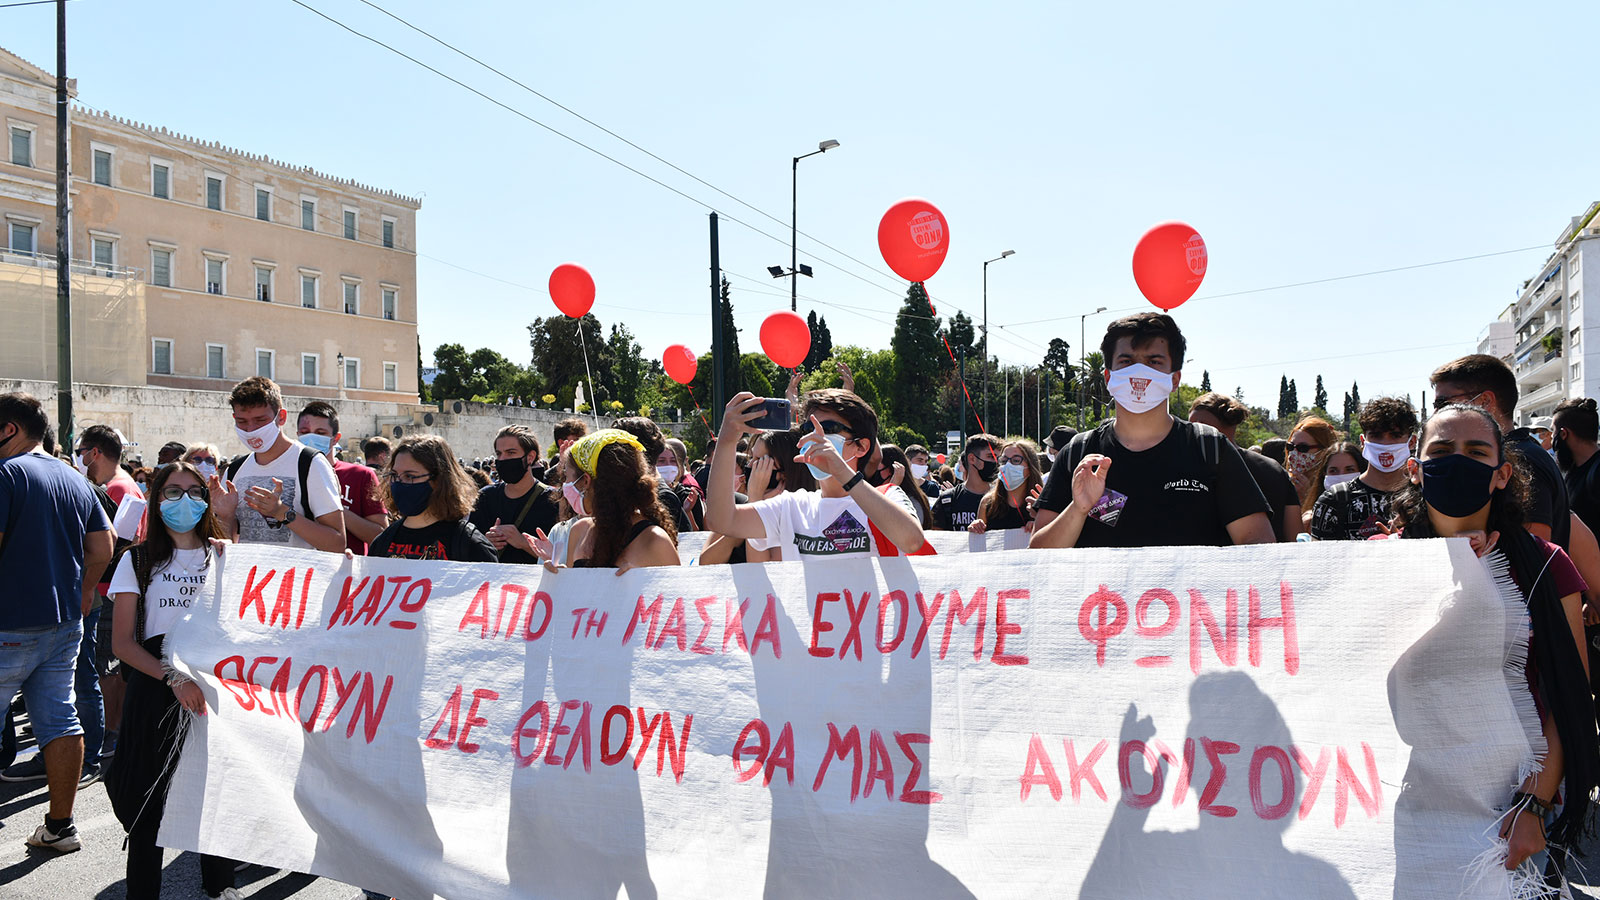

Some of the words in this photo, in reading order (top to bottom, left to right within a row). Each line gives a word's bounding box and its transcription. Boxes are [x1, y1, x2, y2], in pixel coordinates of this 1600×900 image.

[1164, 479, 1189, 490] World
[952, 512, 976, 525] PARIS
[162, 573, 207, 584] MOTHE
[179, 586, 197, 596] OF
[159, 598, 191, 608] DRAG
[238, 565, 314, 630] ΚΑΙ
[327, 575, 433, 630] ΚΑΤΩ
[458, 581, 554, 642] ΑΠΟ
[621, 592, 782, 659] ΜΑΣΚΑ
[808, 586, 1030, 666] ΕΧΟΥΜΕ
[1077, 579, 1301, 676] ΦΩΝΗ
[213, 654, 394, 744] ΘΕΛΟΥΝ
[424, 683, 500, 754] ΔΕ
[510, 699, 693, 784] ΘΕΛΟΥΝ
[732, 718, 795, 788] ΘΑ
[812, 721, 944, 804] ΜΑΣ
